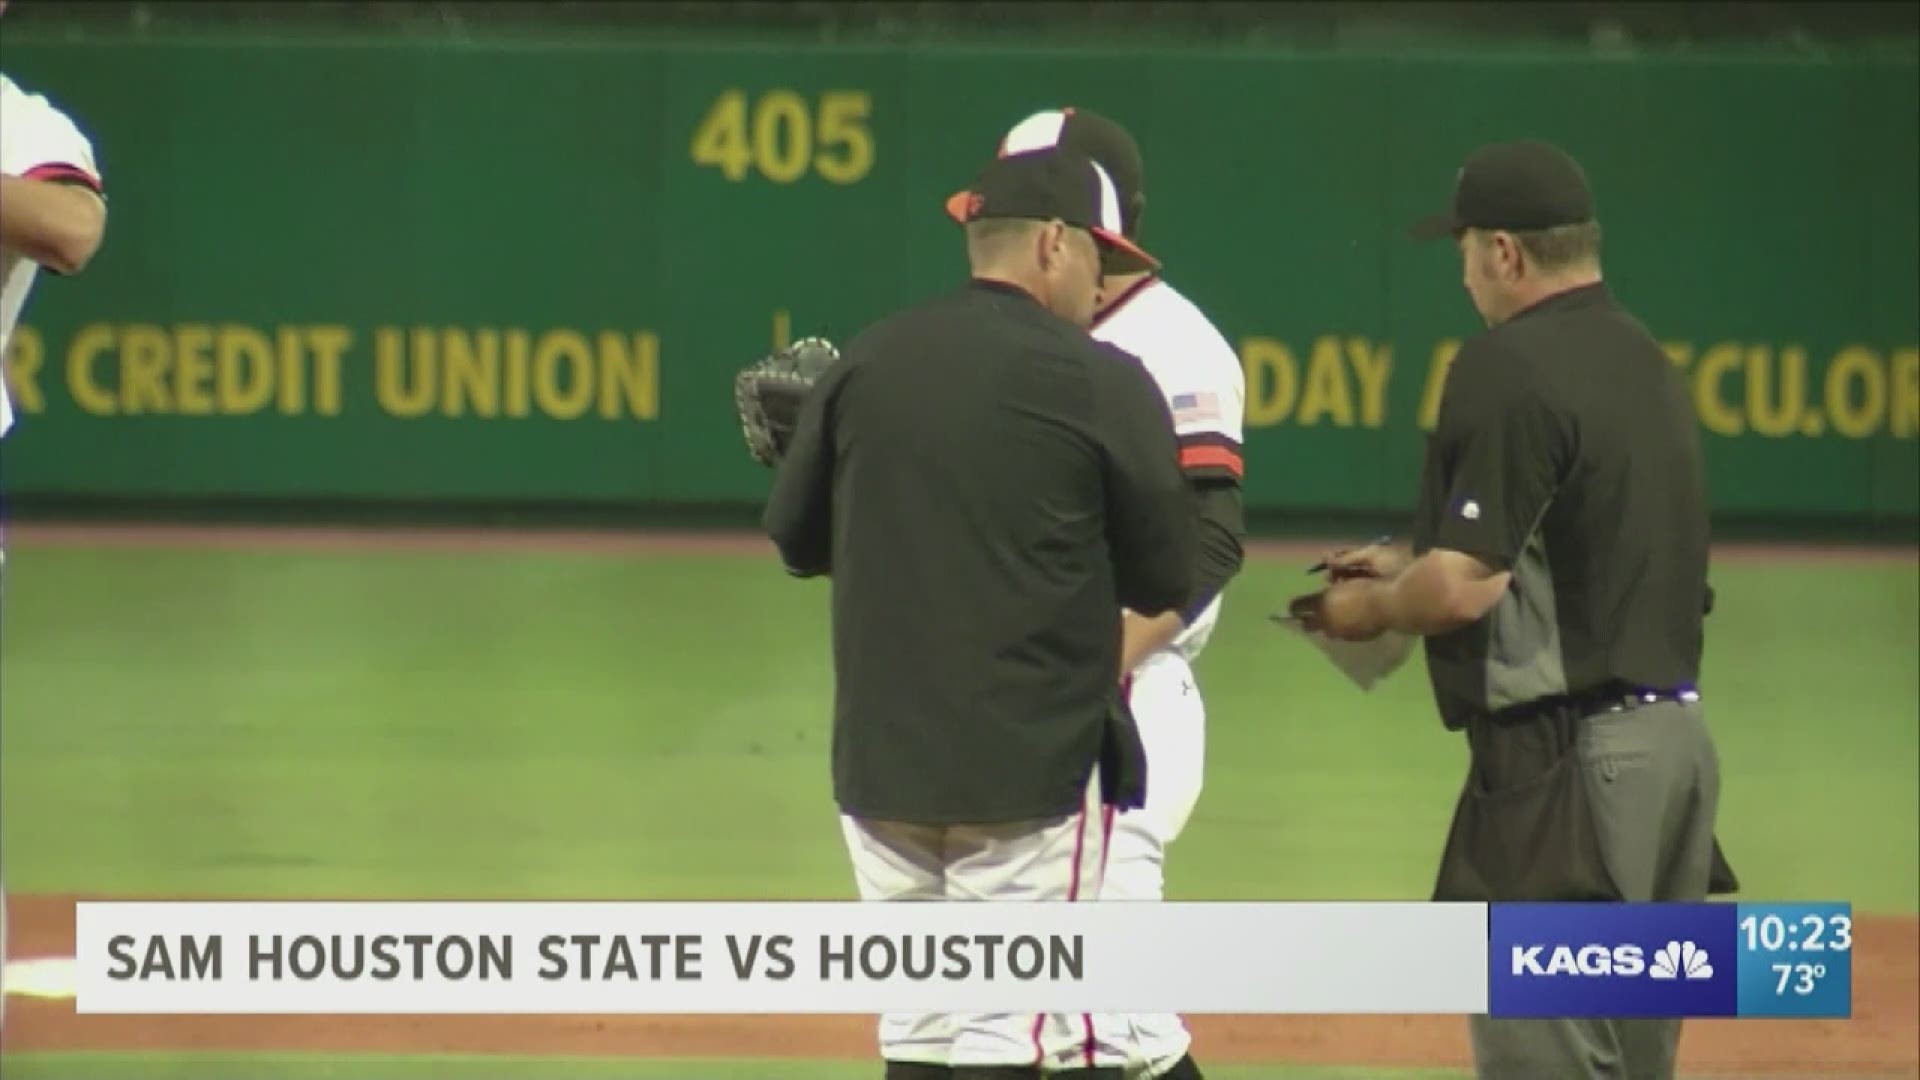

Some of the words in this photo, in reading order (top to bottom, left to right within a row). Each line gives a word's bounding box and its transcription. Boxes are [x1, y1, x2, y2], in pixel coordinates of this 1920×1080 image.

[691, 91, 876, 184] 405
[65, 324, 352, 415] CREDIT
[375, 329, 660, 420] UNION
[1660, 341, 1919, 438] CU.O
